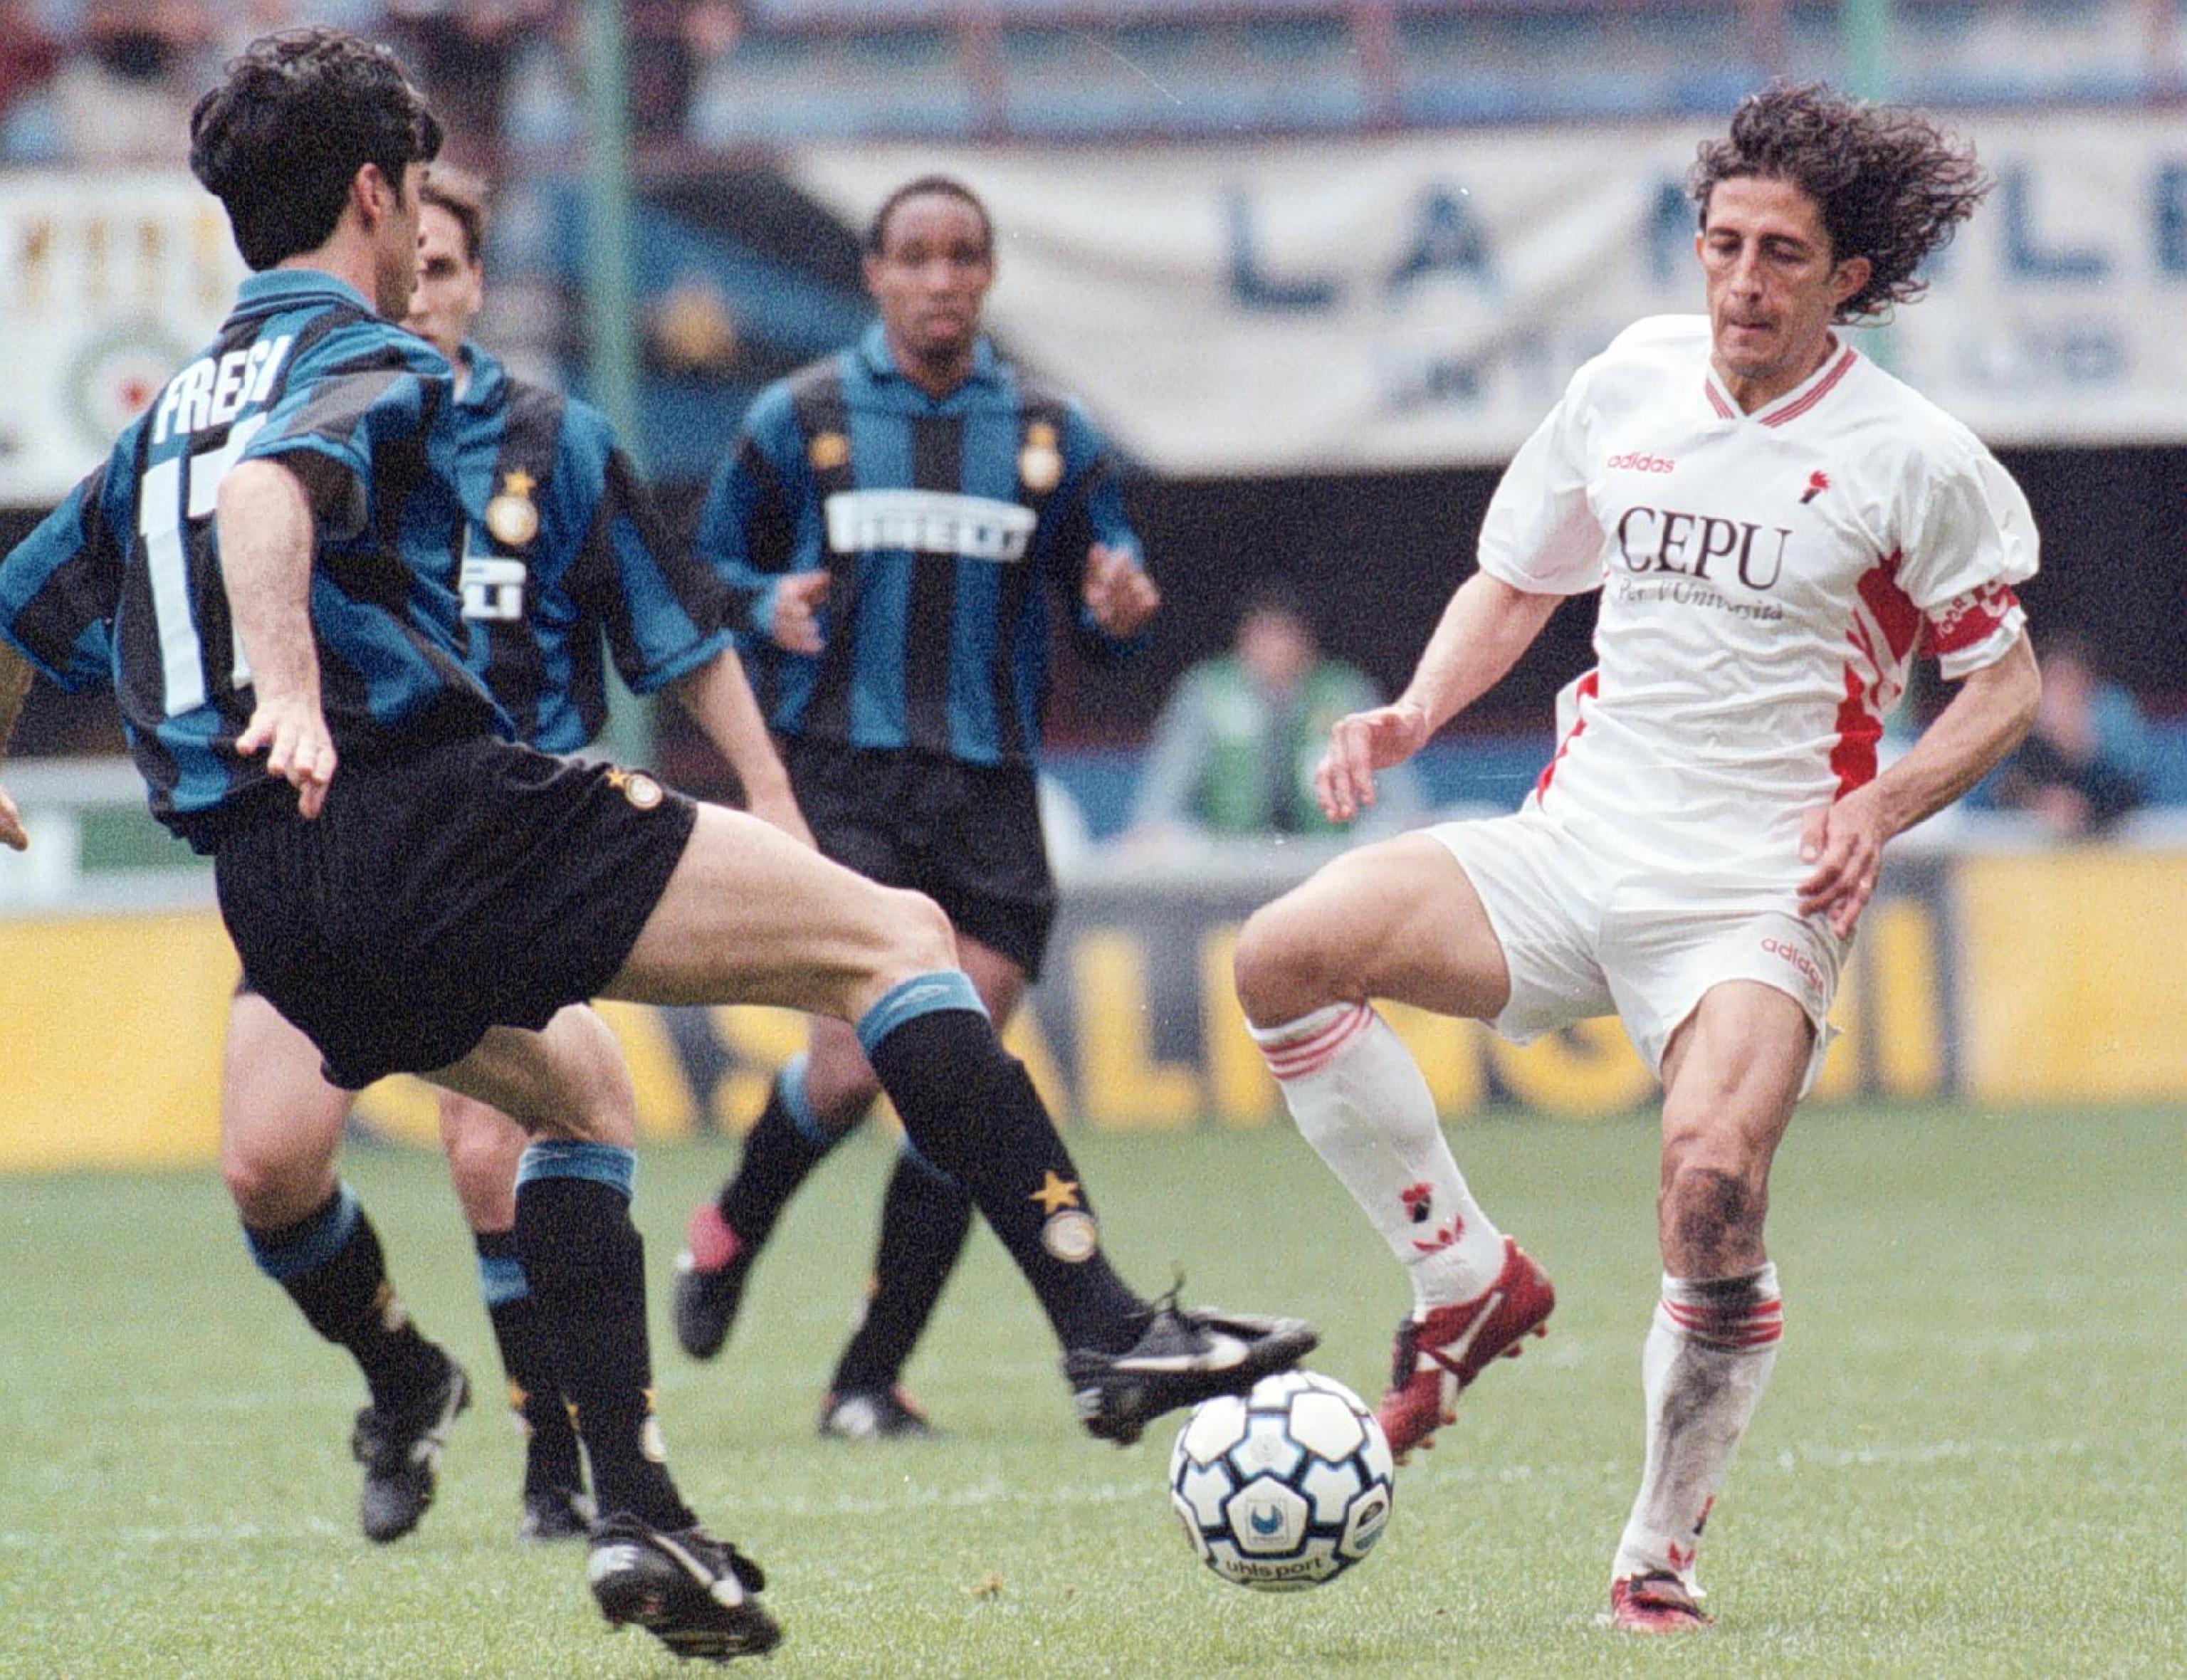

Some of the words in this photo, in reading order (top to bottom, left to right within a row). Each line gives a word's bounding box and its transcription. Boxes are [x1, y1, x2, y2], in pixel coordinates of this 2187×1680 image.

[152, 335, 293, 444] FRESI
[1607, 451, 1675, 474] adidas
[1617, 505, 1793, 591] CEPU
